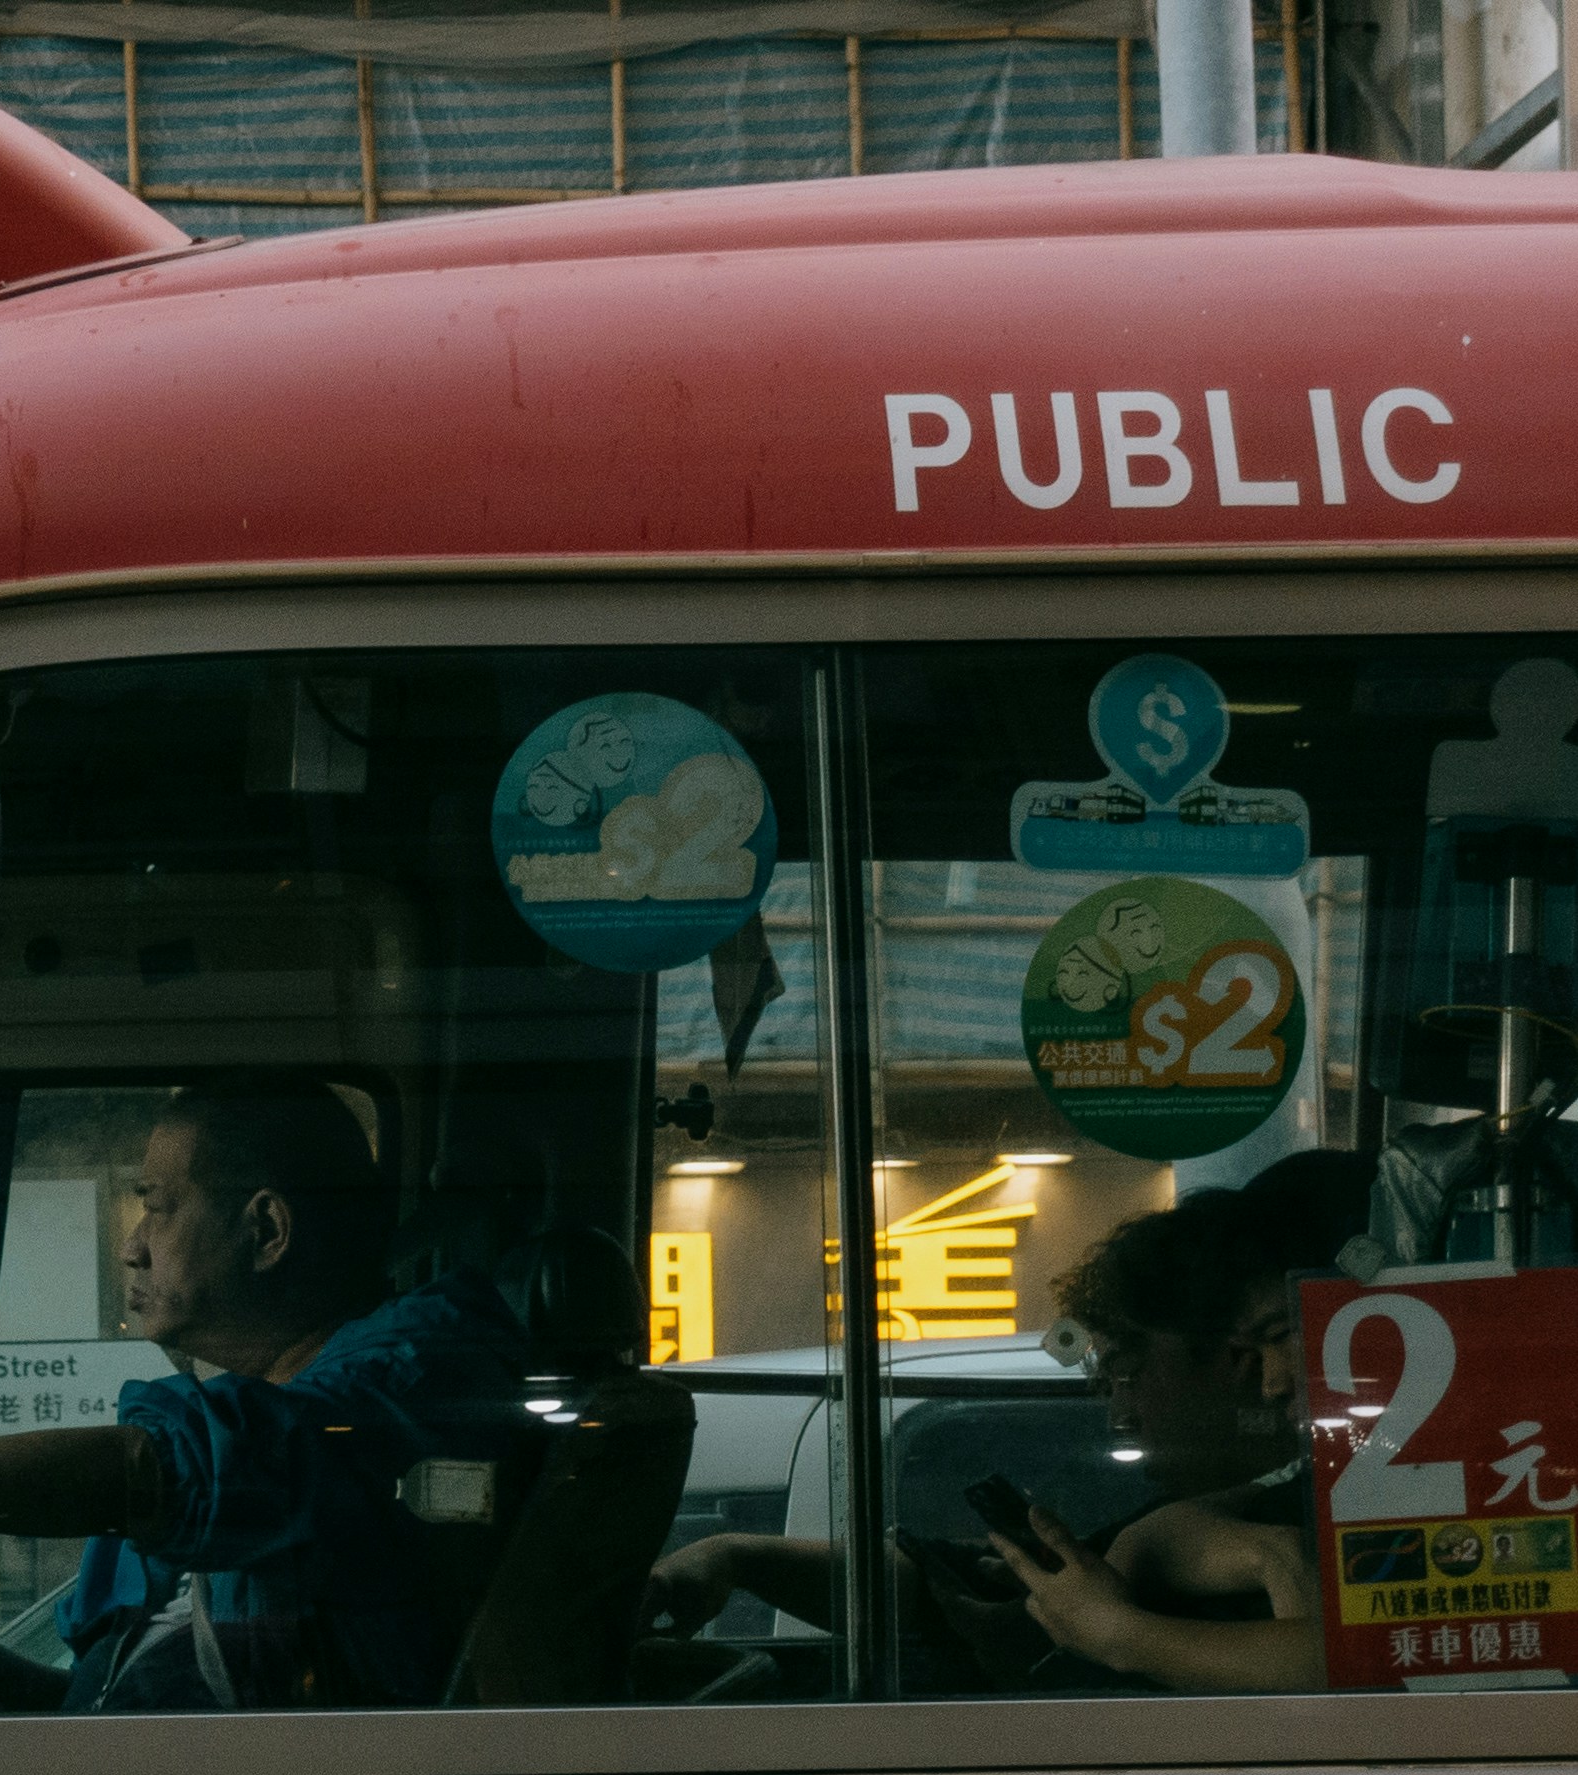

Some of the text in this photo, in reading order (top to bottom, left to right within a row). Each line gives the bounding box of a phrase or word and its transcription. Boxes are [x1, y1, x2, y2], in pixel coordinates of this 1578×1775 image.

[885, 387, 1462, 512] PUBLIC
[1038, 1042, 1128, 1067] 公共交通
[1137, 952, 1276, 1075] $2
[1390, 1619, 1543, 1668] 乘車優惠
